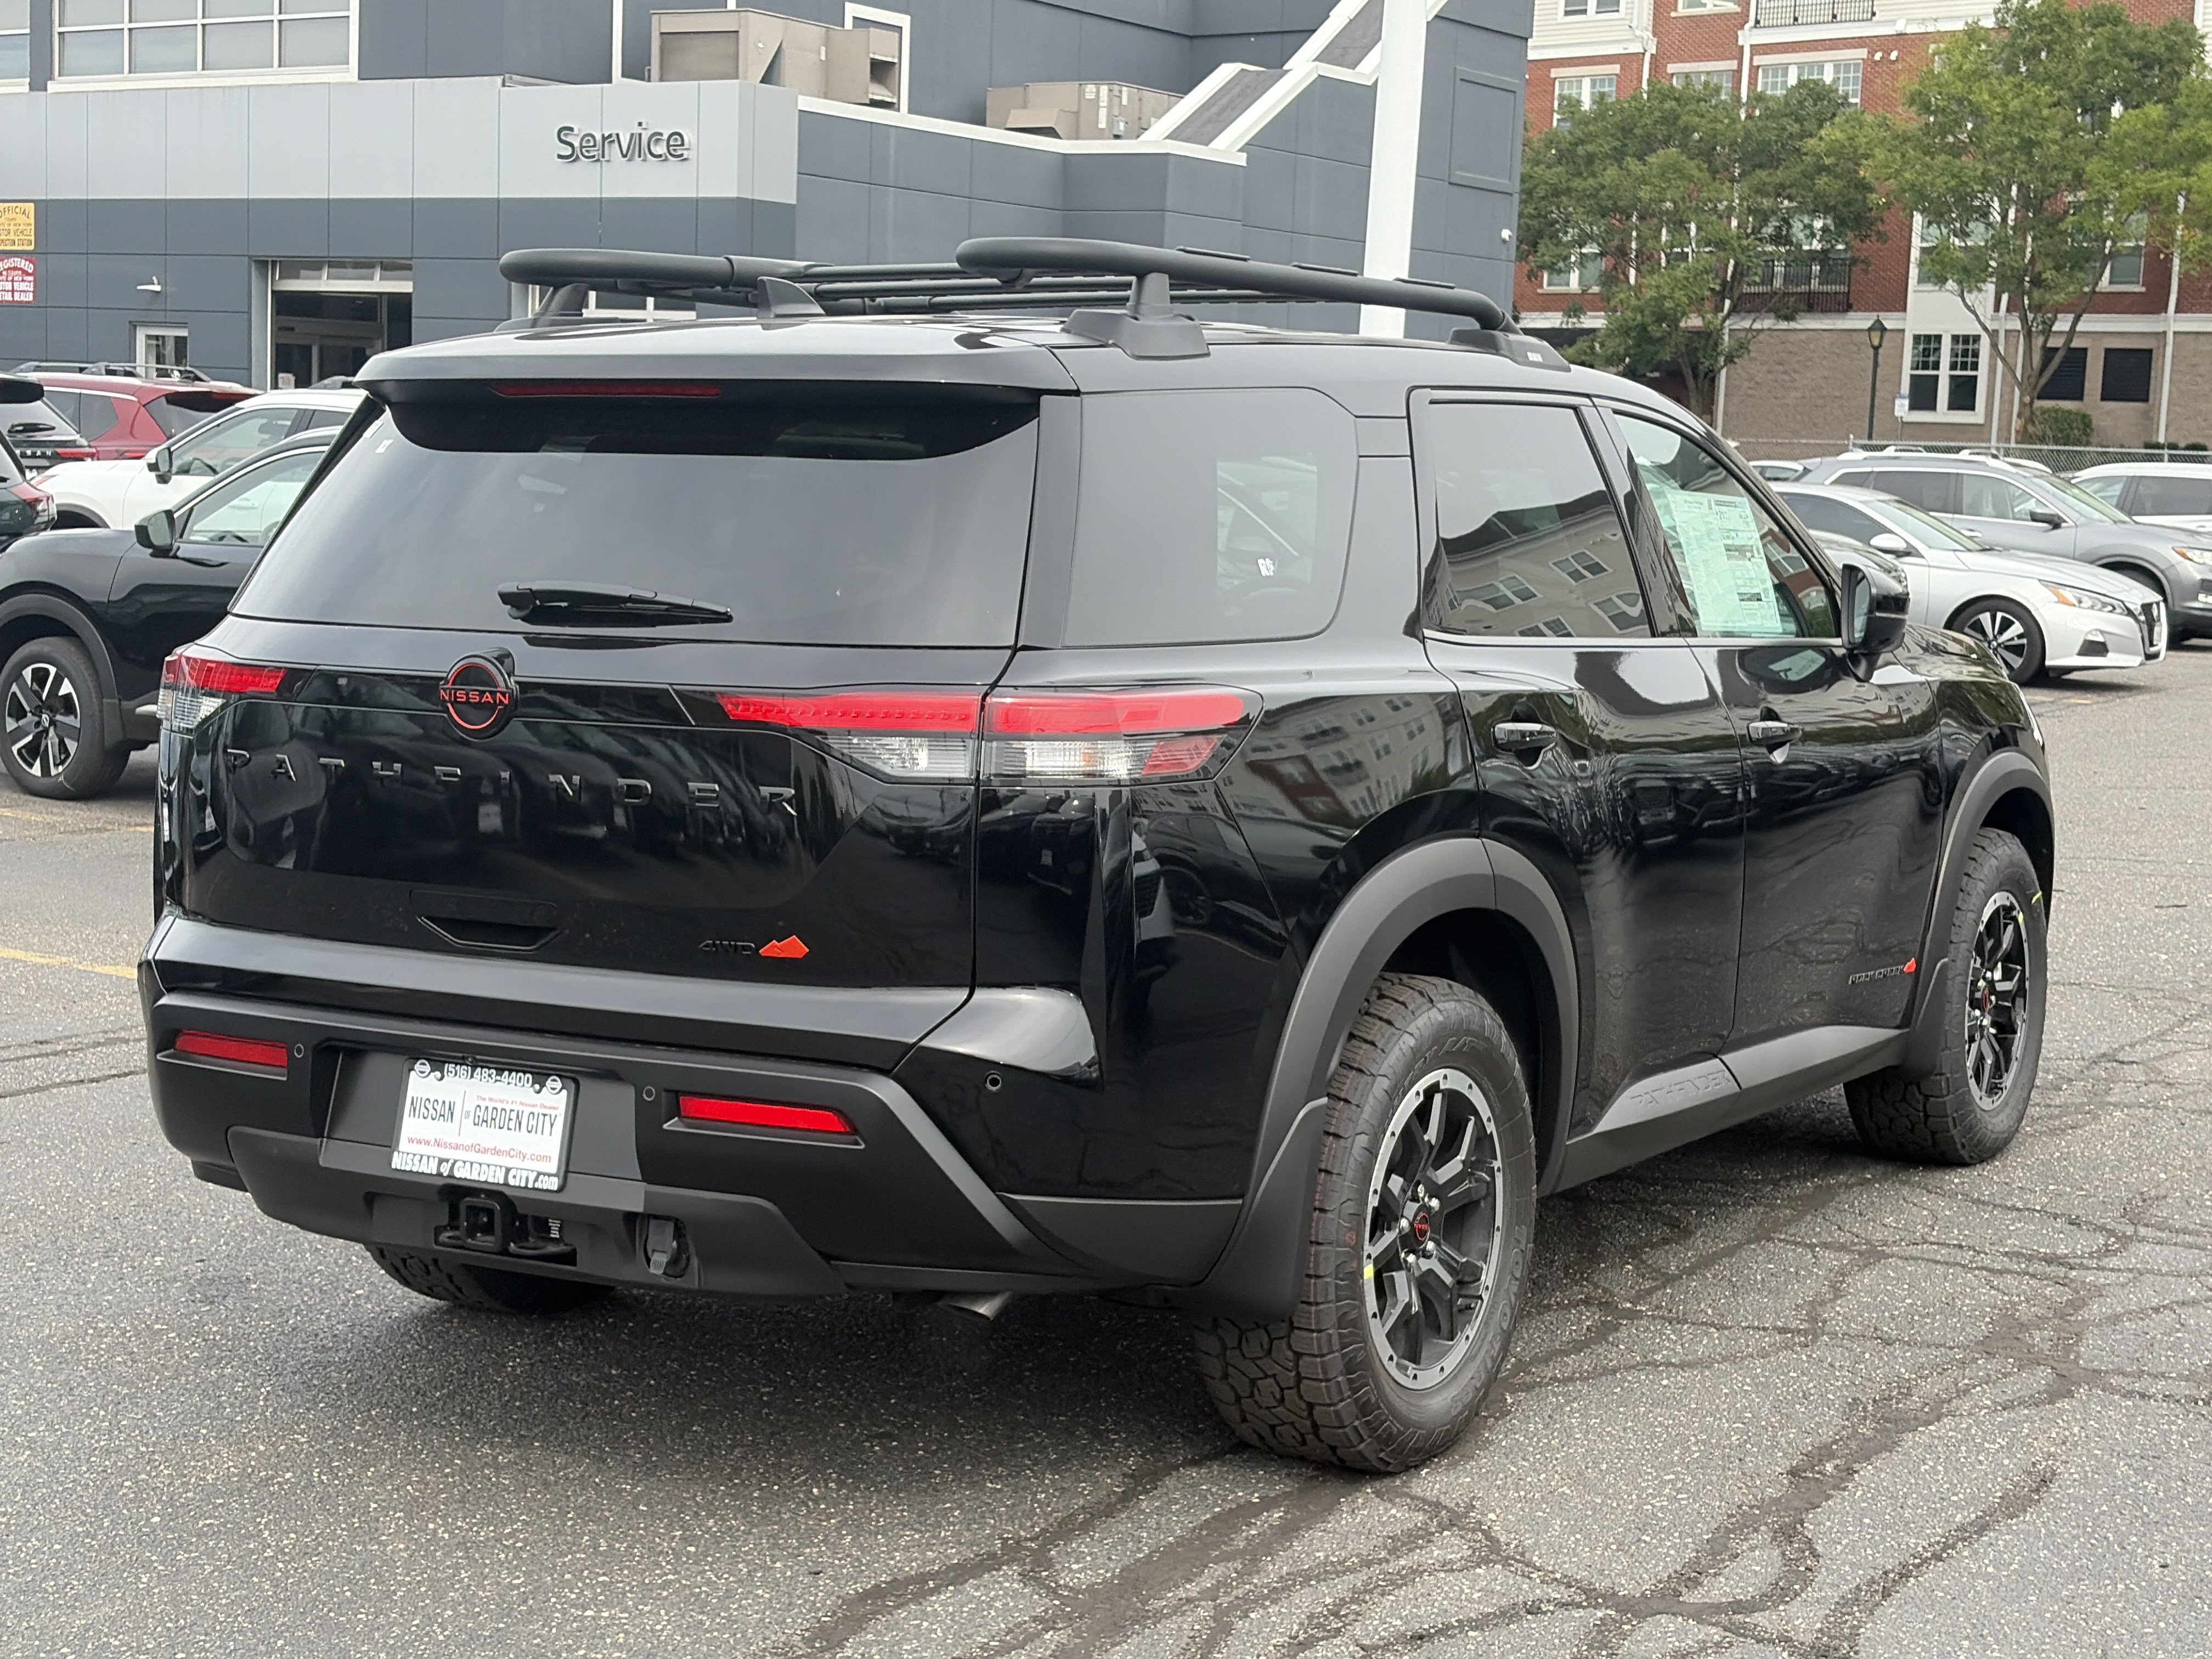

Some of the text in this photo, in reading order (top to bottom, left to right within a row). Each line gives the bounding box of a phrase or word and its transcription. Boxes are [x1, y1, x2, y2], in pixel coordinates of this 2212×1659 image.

[556, 121, 687, 161] Service
[14, 228, 32, 237] VEHICLE
[0, 257, 34, 273] EGISTERED
[0, 281, 34, 291] OTOR VEHICLE
[14, 292, 33, 302] DEALER
[439, 688, 510, 705] NISSAN
[226, 748, 798, 817] PATHFINDER
[697, 939, 757, 955] 4WD
[444, 1063, 533, 1088] (516) 483-4400
[408, 1096, 558, 1137] NISSAN OF GARDEN CITY
[407, 1136, 552, 1164] www.NissanofGardenCity.com
[391, 1151, 559, 1191] NISSAN of GARDEN CITY.com
